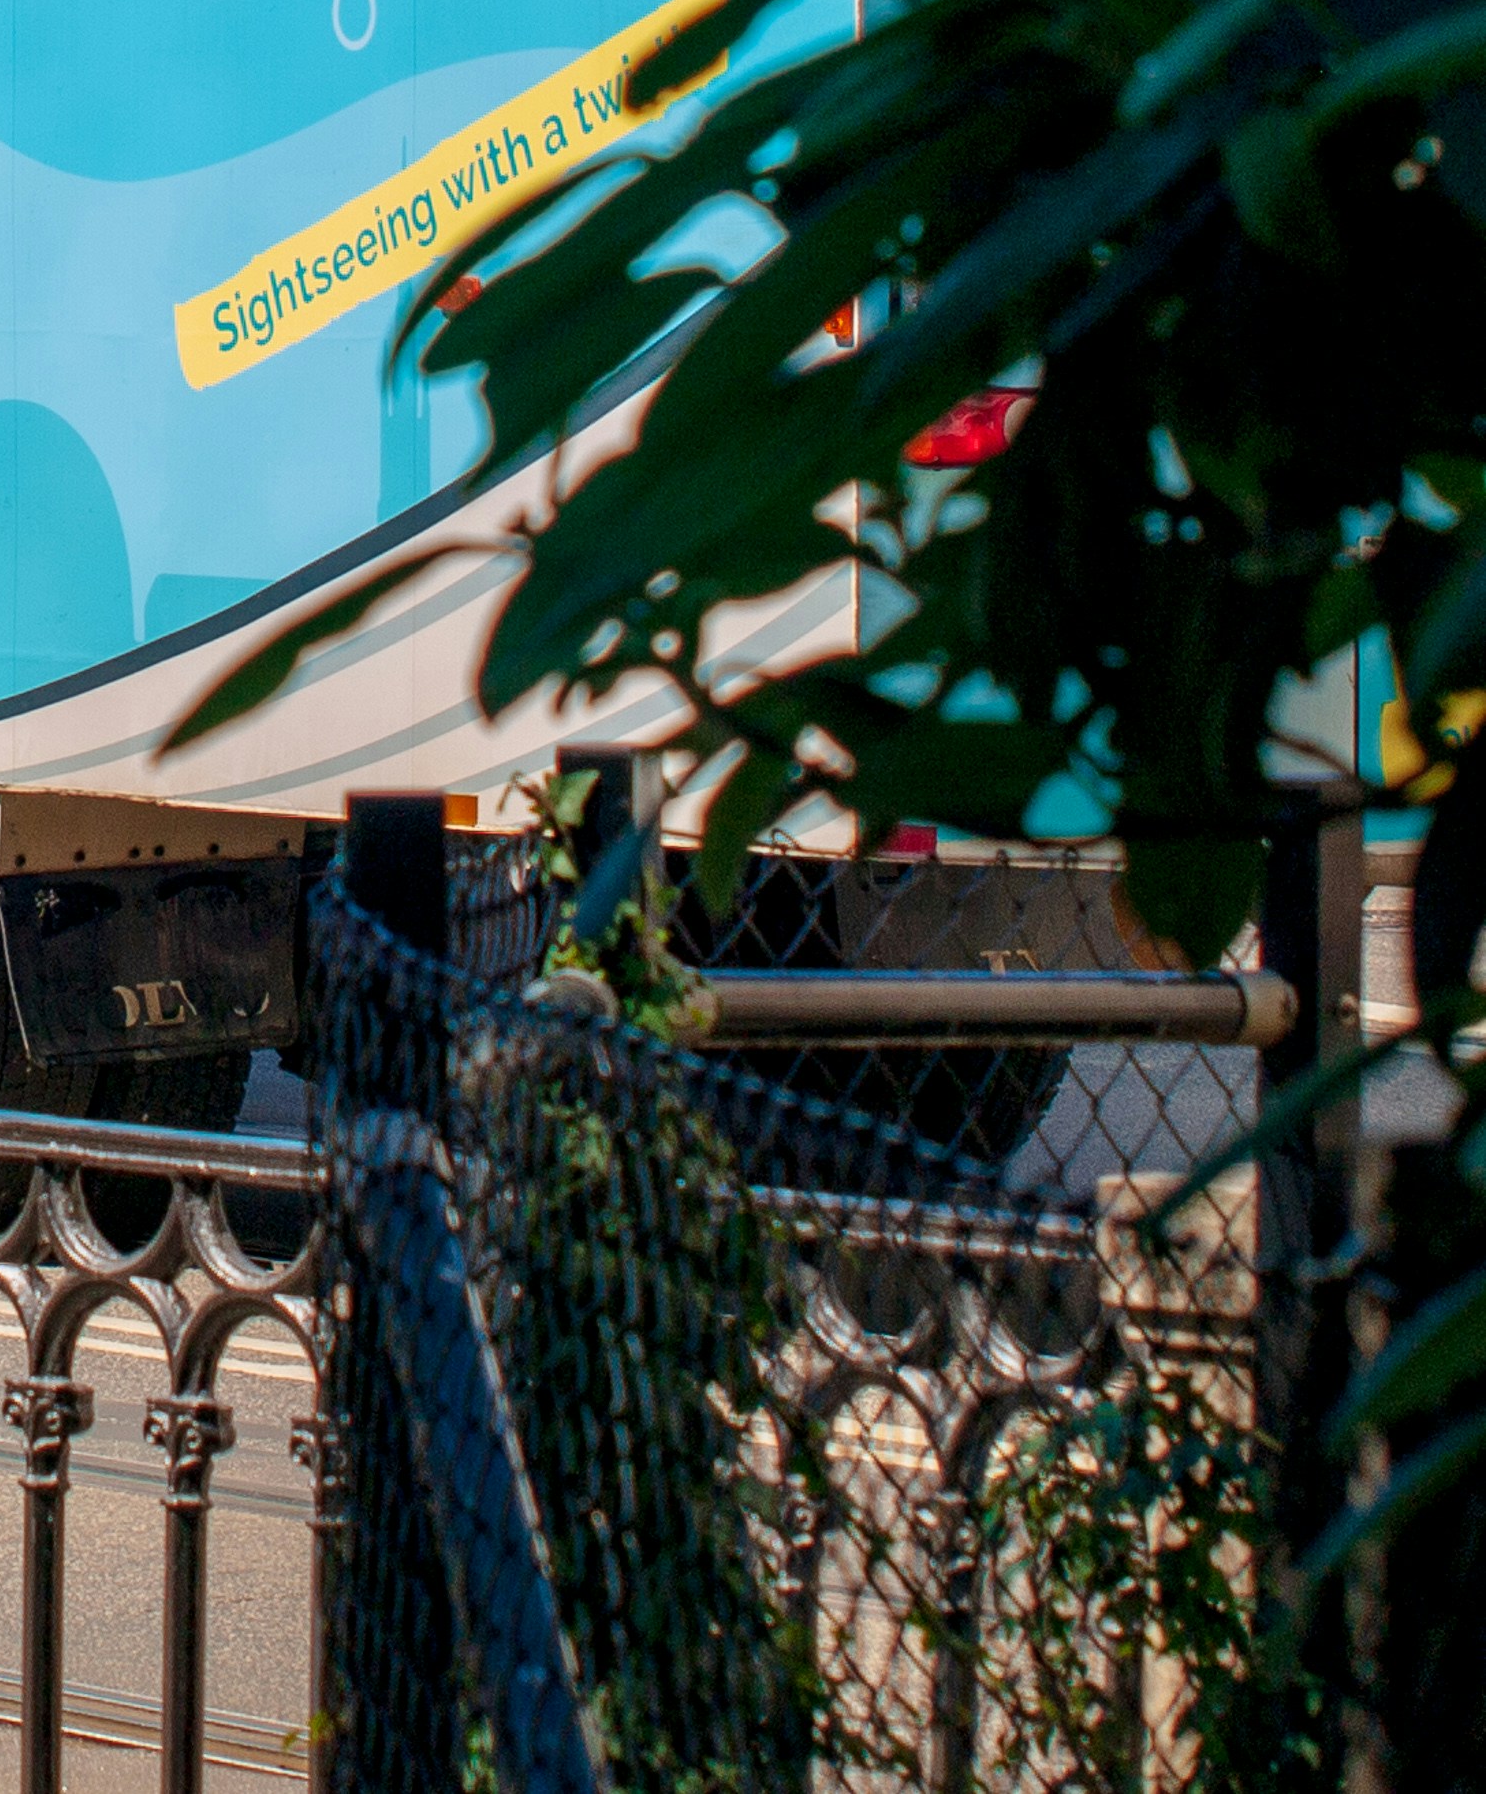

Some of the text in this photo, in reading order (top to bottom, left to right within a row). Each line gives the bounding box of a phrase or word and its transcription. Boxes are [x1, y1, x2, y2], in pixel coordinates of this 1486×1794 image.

[213, 189, 437, 351] Sightseeing
[441, 127, 534, 210] with
[541, 115, 569, 155] a
